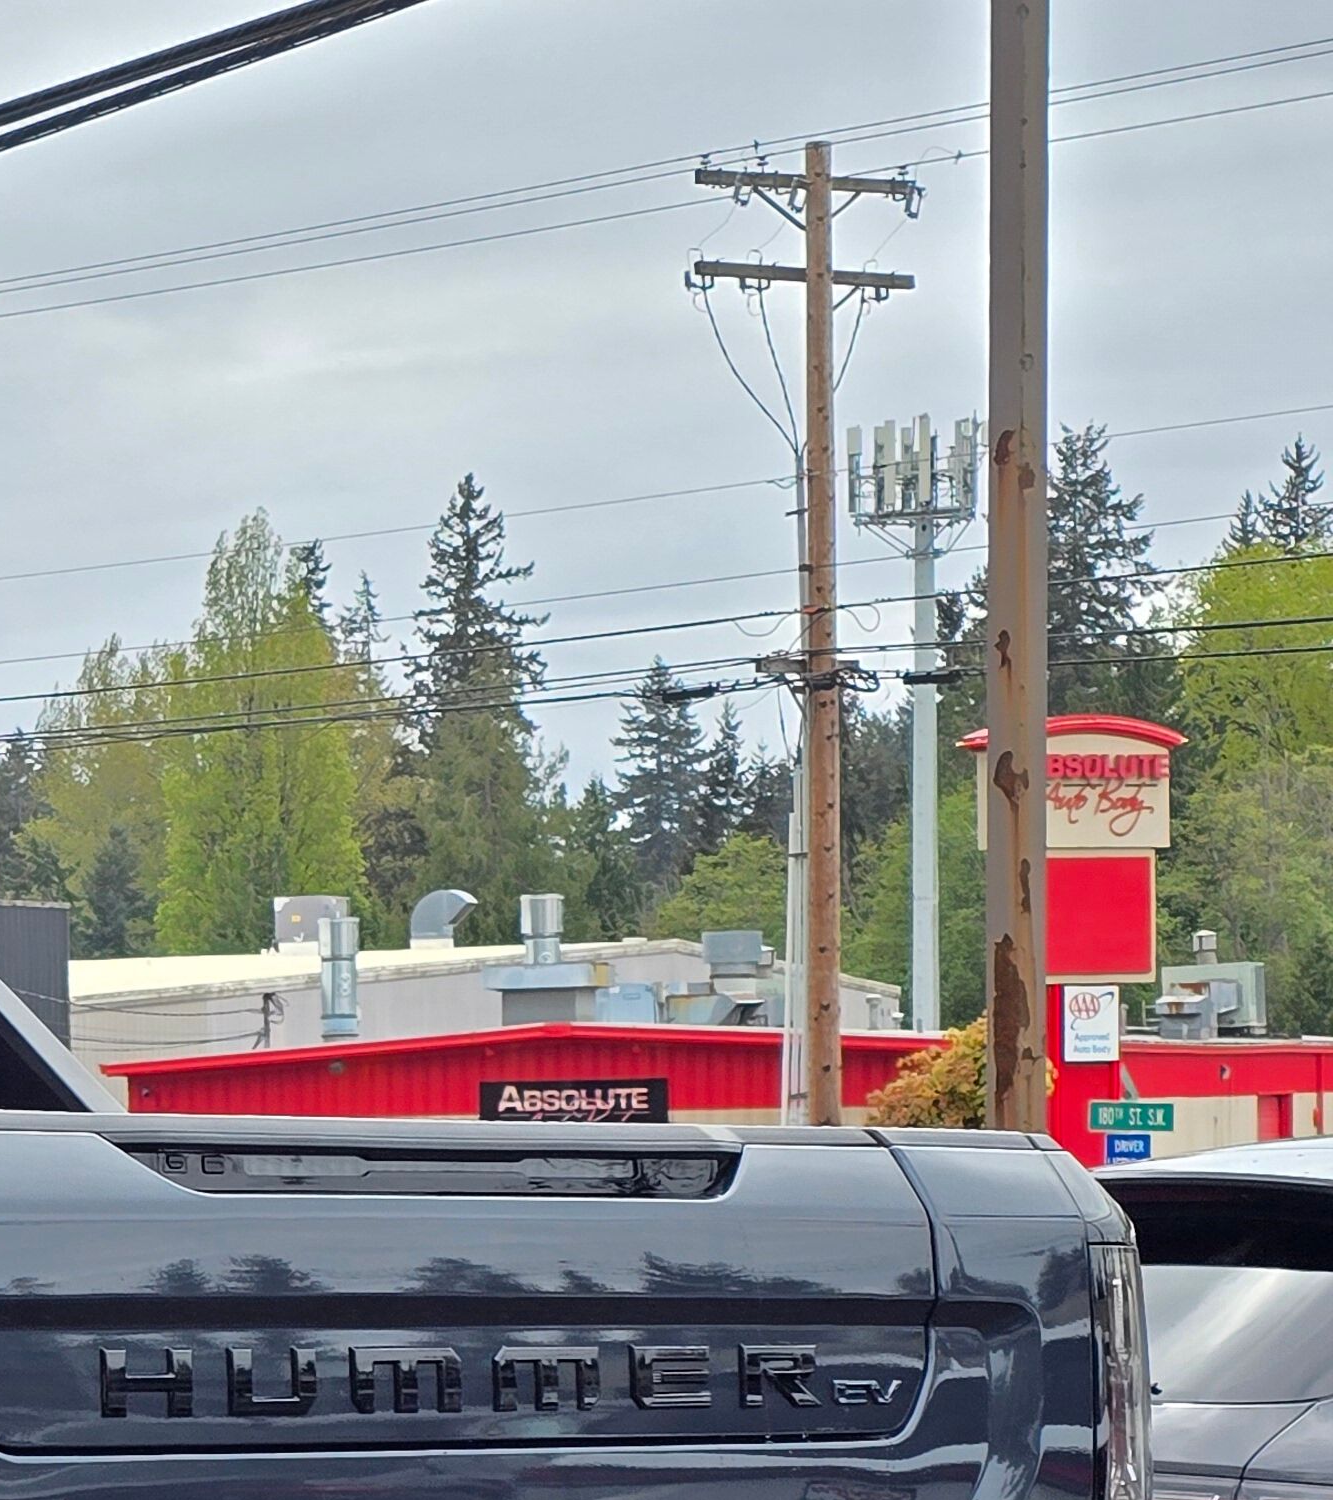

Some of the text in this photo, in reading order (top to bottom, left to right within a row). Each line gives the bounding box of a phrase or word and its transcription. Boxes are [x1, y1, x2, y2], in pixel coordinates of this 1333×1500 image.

[1046, 754, 1170, 778] BSOLUTE
[498, 1085, 649, 1112] ABSOLUTE
[1114, 1139, 1144, 1153] DRIVER
[99, 1342, 902, 1418] HUMMER EV
